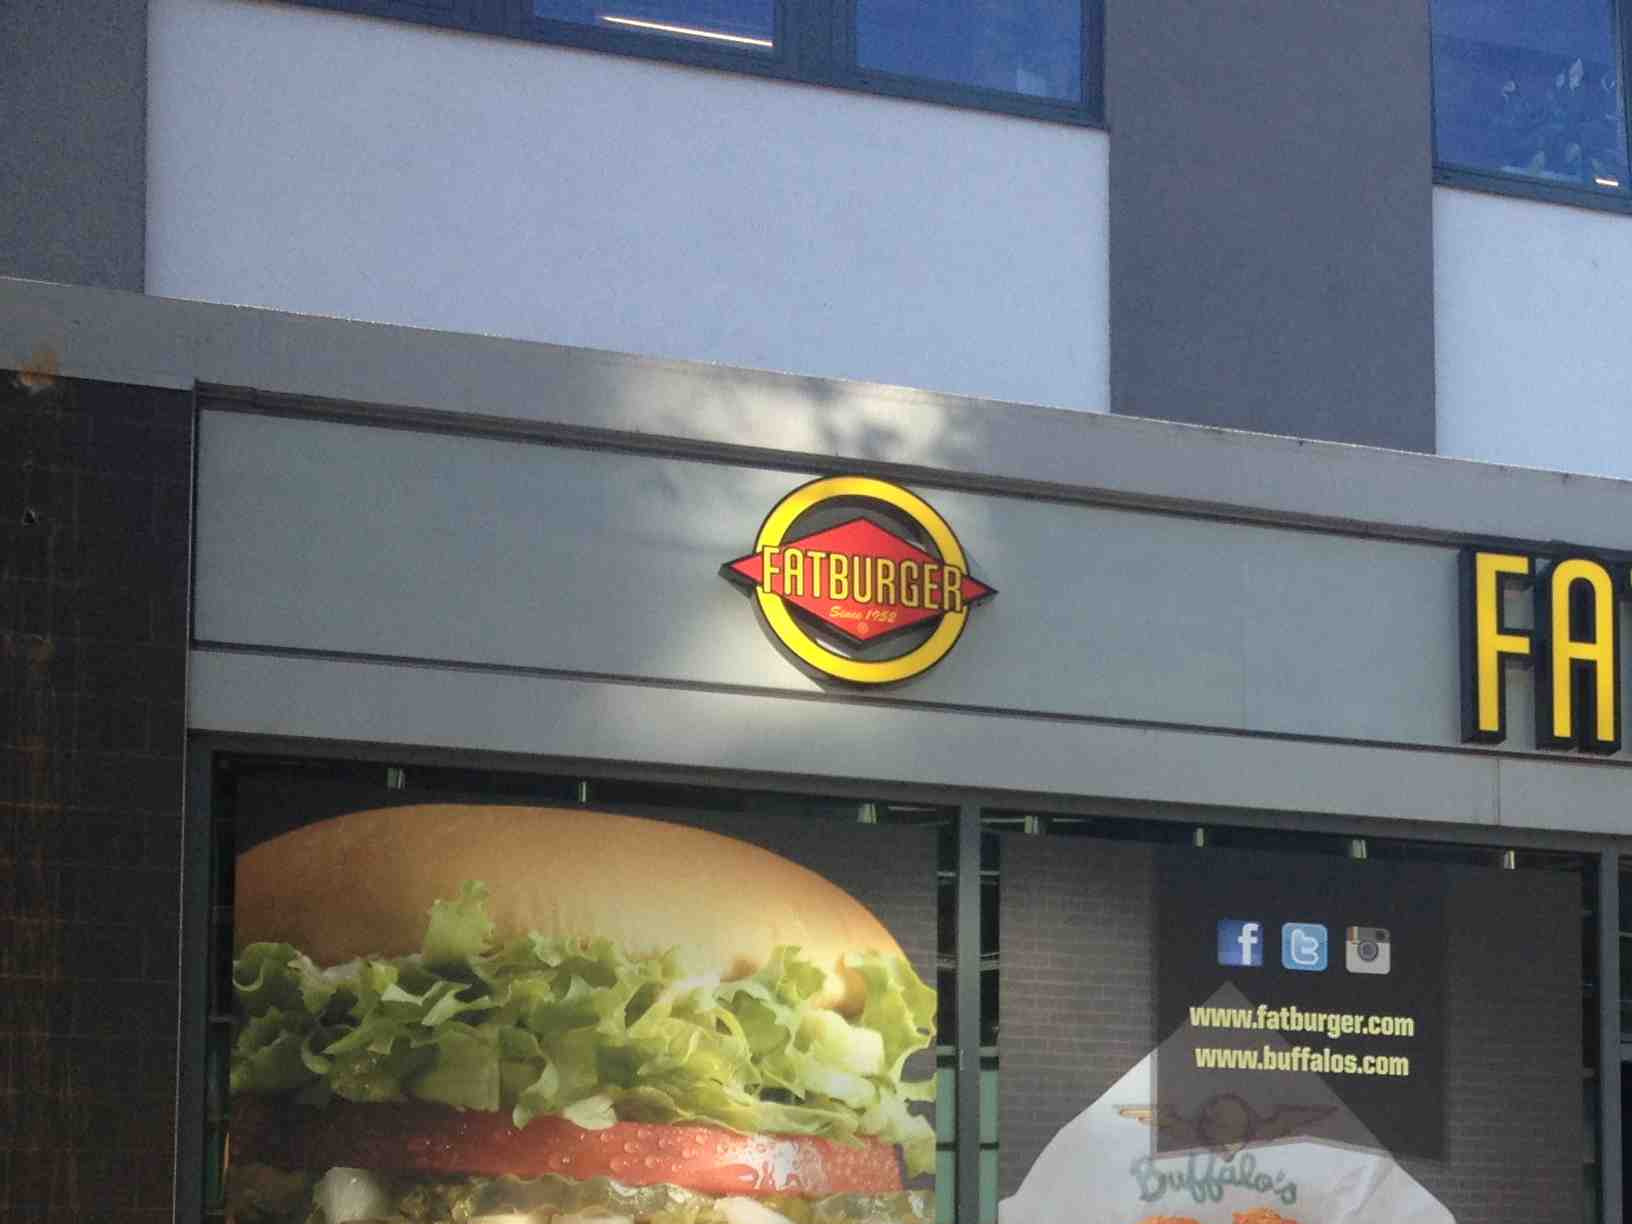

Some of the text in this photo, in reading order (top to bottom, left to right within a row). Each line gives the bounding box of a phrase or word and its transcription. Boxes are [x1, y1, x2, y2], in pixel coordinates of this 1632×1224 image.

[762, 545, 963, 613] FATBURGER
[1189, 1004, 1415, 1039] www.fatburger.com
[1195, 1045, 1409, 1077] www.buffalos.com
